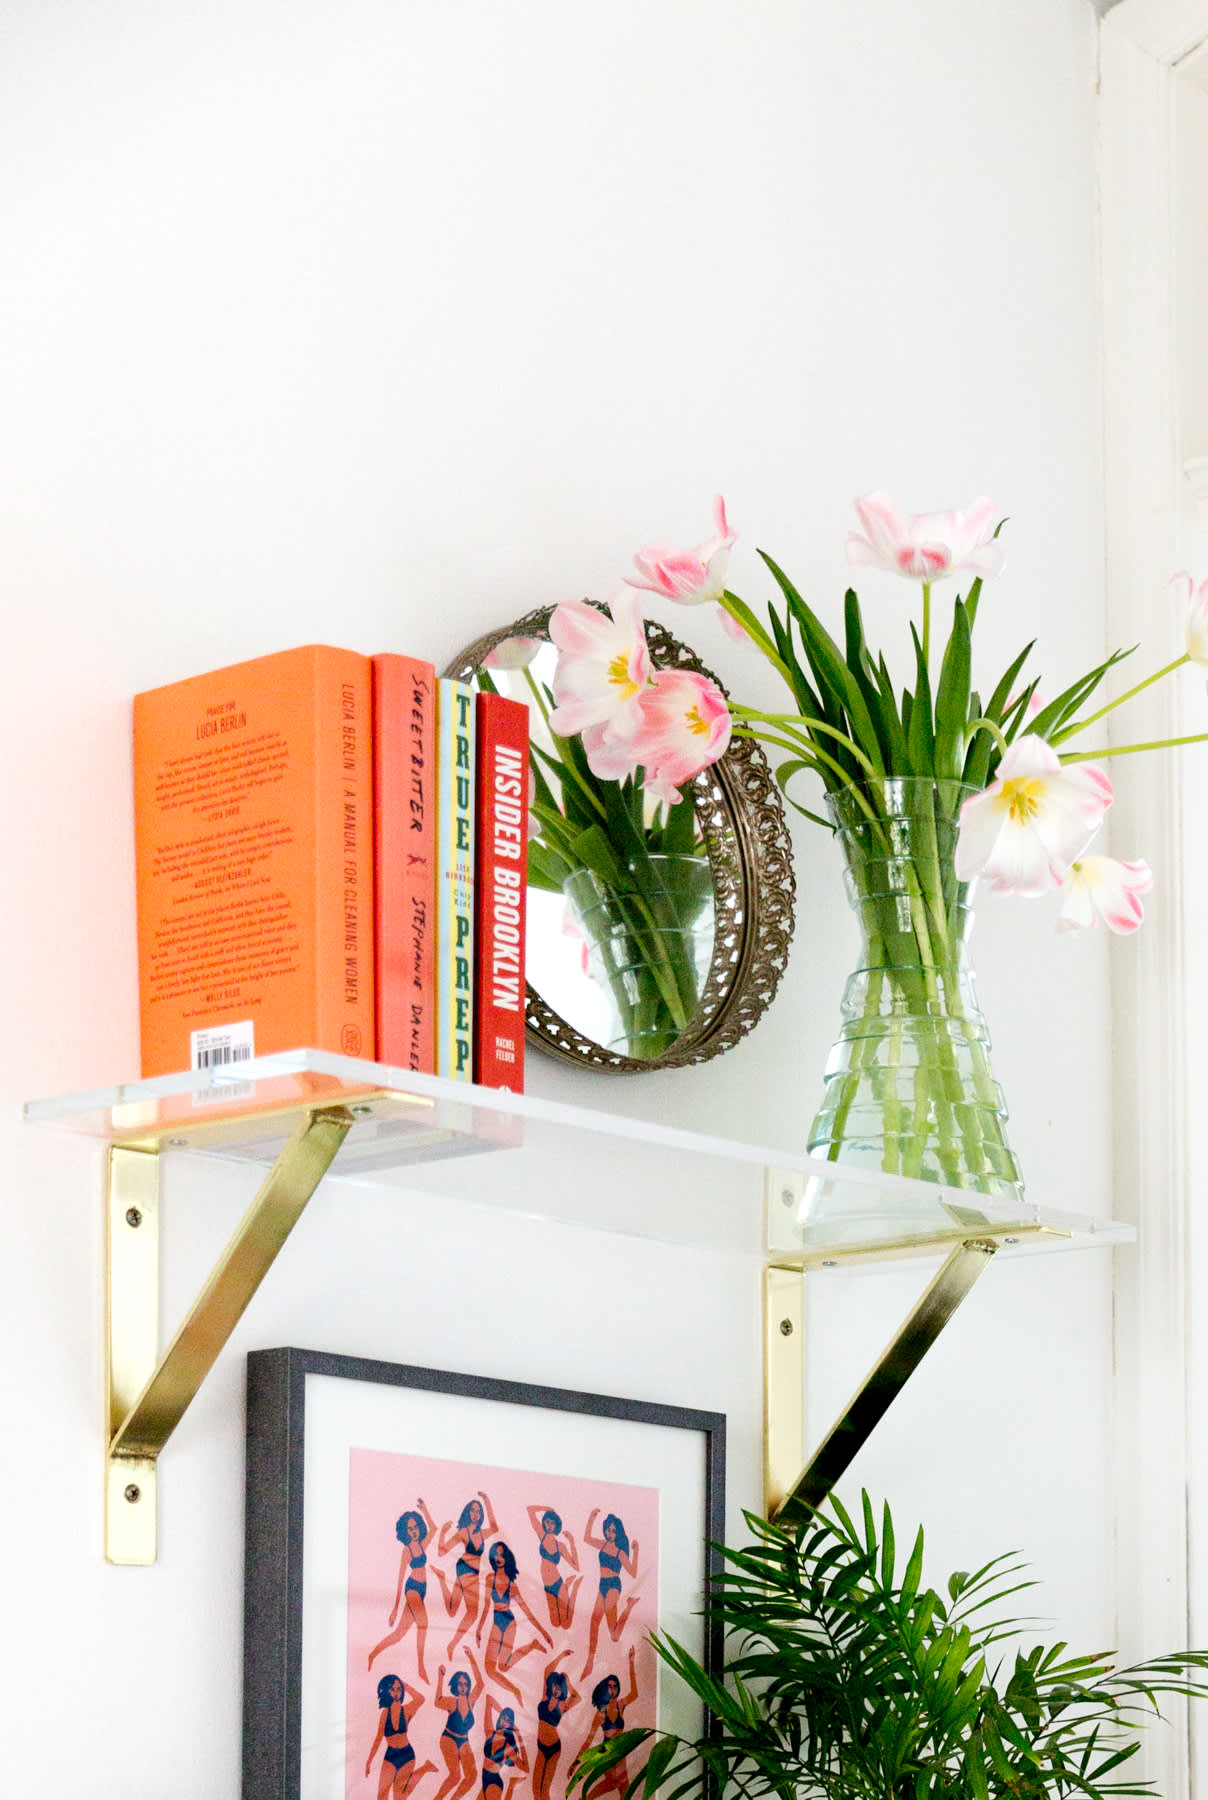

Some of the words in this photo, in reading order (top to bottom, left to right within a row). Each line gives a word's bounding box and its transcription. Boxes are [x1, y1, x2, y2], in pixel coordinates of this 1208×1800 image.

[196, 718, 218, 741] LUCIA
[220, 712, 247, 734] BERLIN
[342, 684, 355, 720] LUCIA
[342, 727, 356, 770] BERLIN
[410, 674, 429, 832] SWEETBITTER
[456, 694, 470, 851] TRUE
[344, 802, 356, 853] MANUAL
[493, 745, 522, 860] INSIDER
[344, 861, 358, 886] FOR
[344, 890, 358, 953] CLEANING
[411, 897, 426, 990] STEPHANIE
[492, 867, 521, 1012] BROOKLYN
[345, 958, 359, 1004] WOMEN
[456, 915, 469, 1072] PREP
